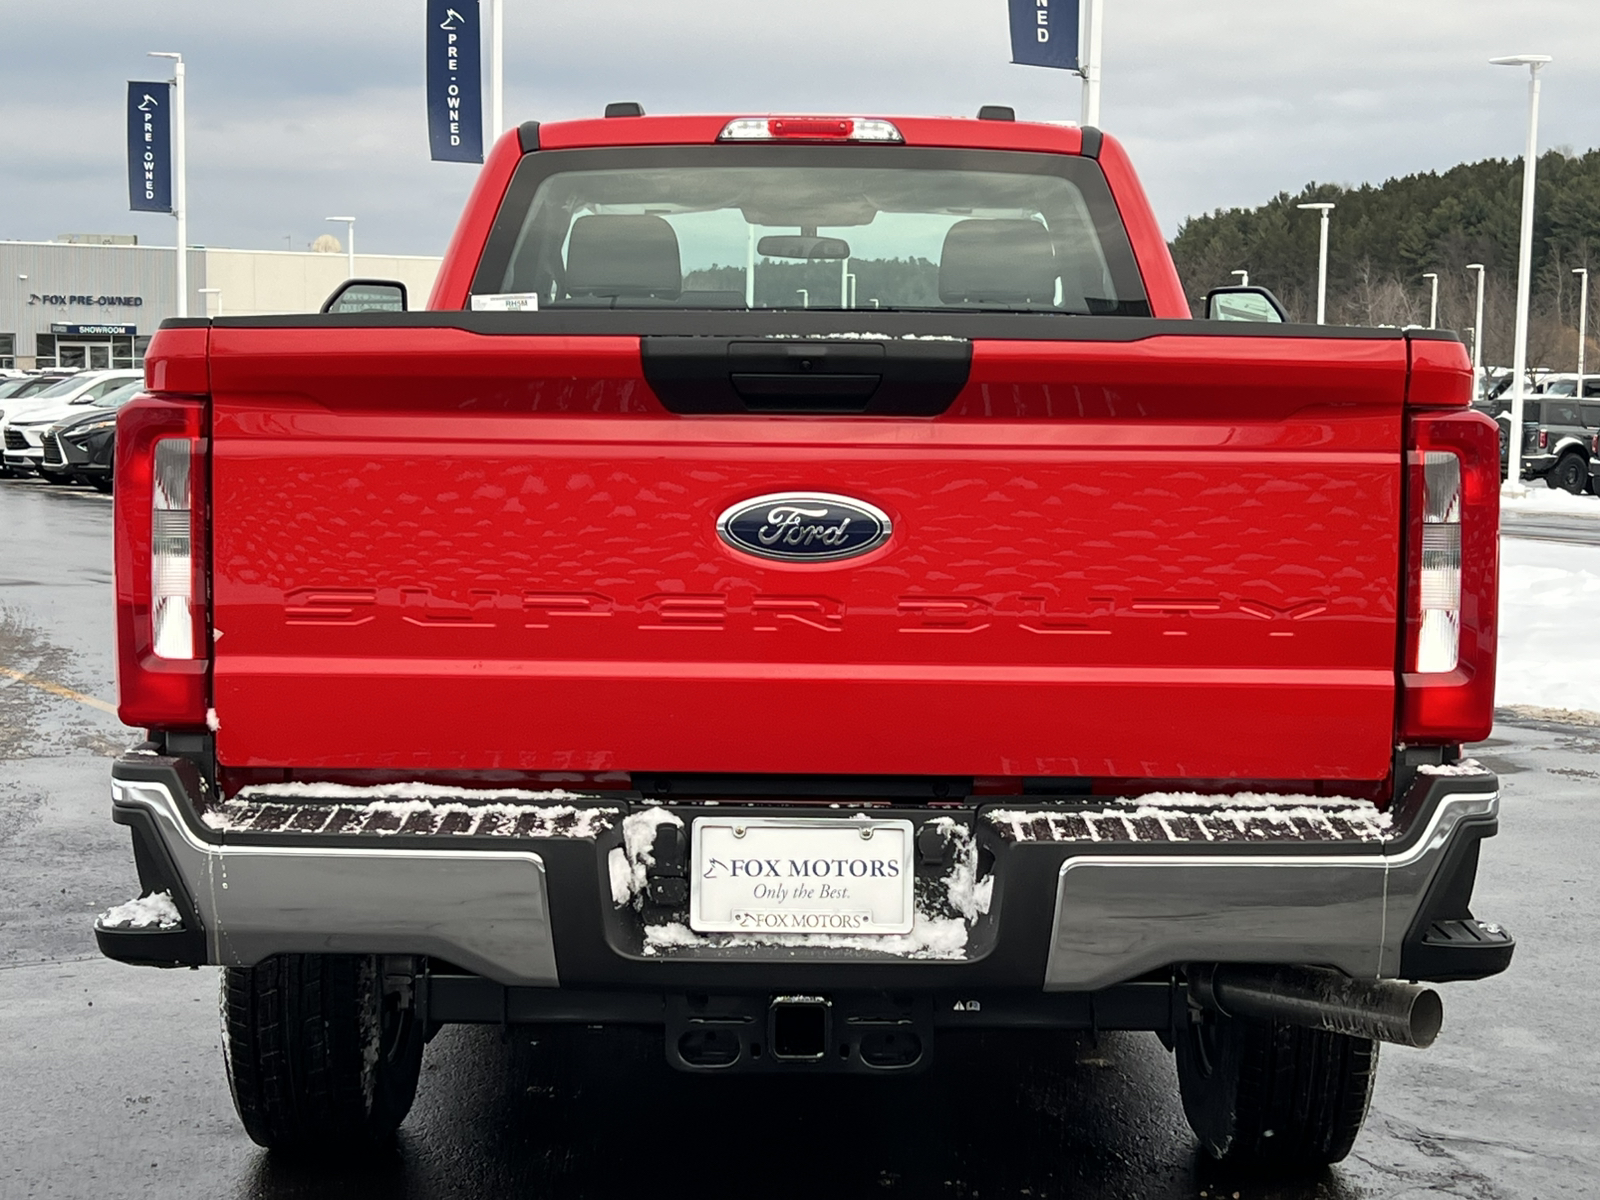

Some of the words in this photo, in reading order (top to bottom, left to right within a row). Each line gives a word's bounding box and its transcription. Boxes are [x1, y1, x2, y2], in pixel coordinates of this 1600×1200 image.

[447, 33, 460, 146] PRE-OWNED
[143, 113, 154, 199] PRE-OWNED
[42, 295, 67, 305] FOX
[69, 295, 143, 306] PRE-OWNED
[79, 326, 125, 334] SHOWROOM
[758, 506, 851, 546] Ford
[283, 586, 843, 633] SUPER
[897, 595, 1327, 637] DUTY
[730, 859, 781, 877] FOX
[789, 859, 899, 877] MOTORS
[753, 884, 788, 904] Only
[793, 883, 814, 899] the
[819, 884, 850, 899] Best.
[756, 914, 789, 928] FOX
[792, 914, 861, 929] MOTORS
